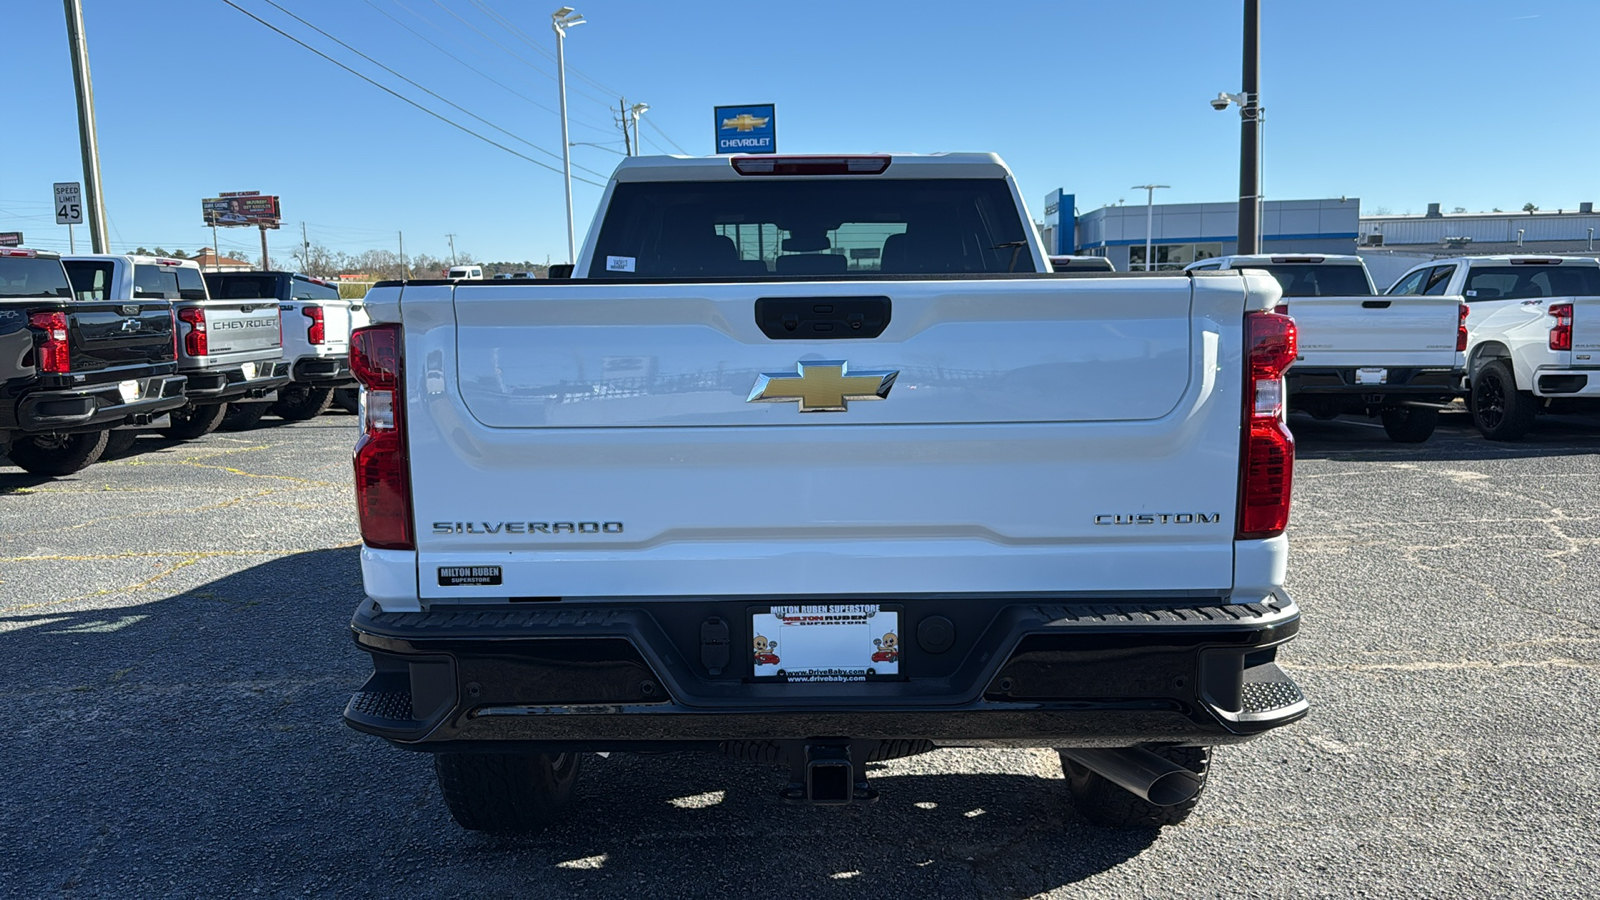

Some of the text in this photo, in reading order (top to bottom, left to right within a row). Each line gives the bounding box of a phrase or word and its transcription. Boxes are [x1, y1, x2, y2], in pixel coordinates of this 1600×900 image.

[720, 138, 770, 148] CHEVROLET
[56, 187, 79, 195] SPEED
[58, 204, 80, 220] 45
[213, 318, 277, 331] CHEVROLET
[1094, 512, 1220, 526] CUSTOM
[432, 521, 625, 535] SILVERADO
[441, 567, 499, 577] MILTON RUBEN
[770, 604, 880, 614] MILTON RUBEN SUPERSTORE
[786, 669, 865, 677] www.DriveBaby.com
